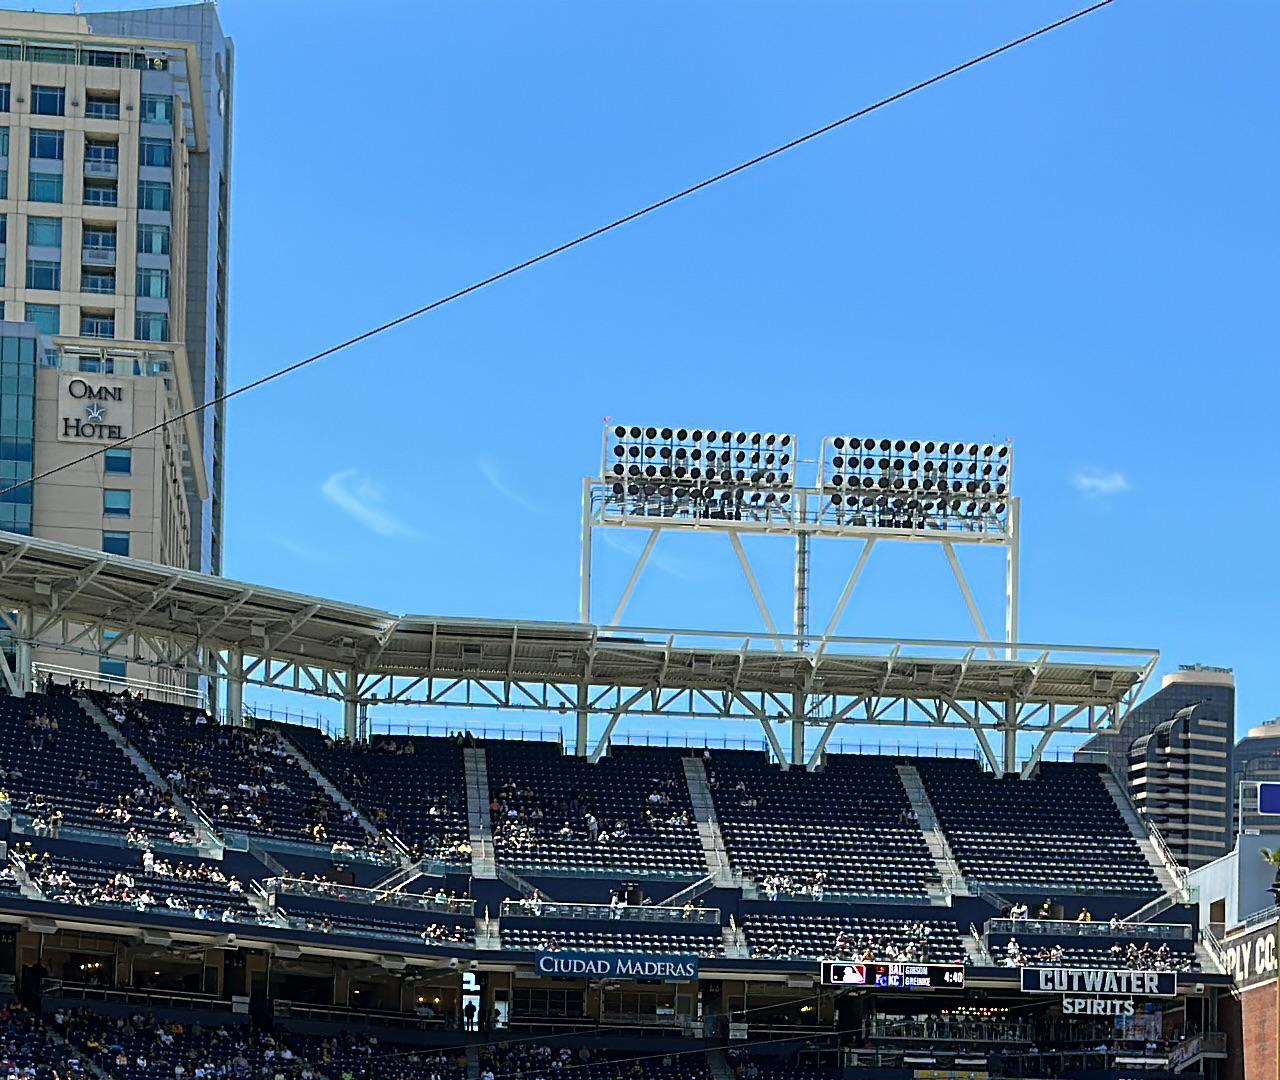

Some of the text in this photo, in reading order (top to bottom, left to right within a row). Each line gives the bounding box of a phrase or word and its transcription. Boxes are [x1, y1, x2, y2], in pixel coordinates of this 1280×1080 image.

[69, 379, 122, 401] OMNI
[63, 417, 127, 440] HOTEL
[539, 956, 695, 977] CIUDAD MADERAS
[1039, 970, 1159, 993] CUTWATER
[1063, 998, 1135, 1016] SPIRITS
